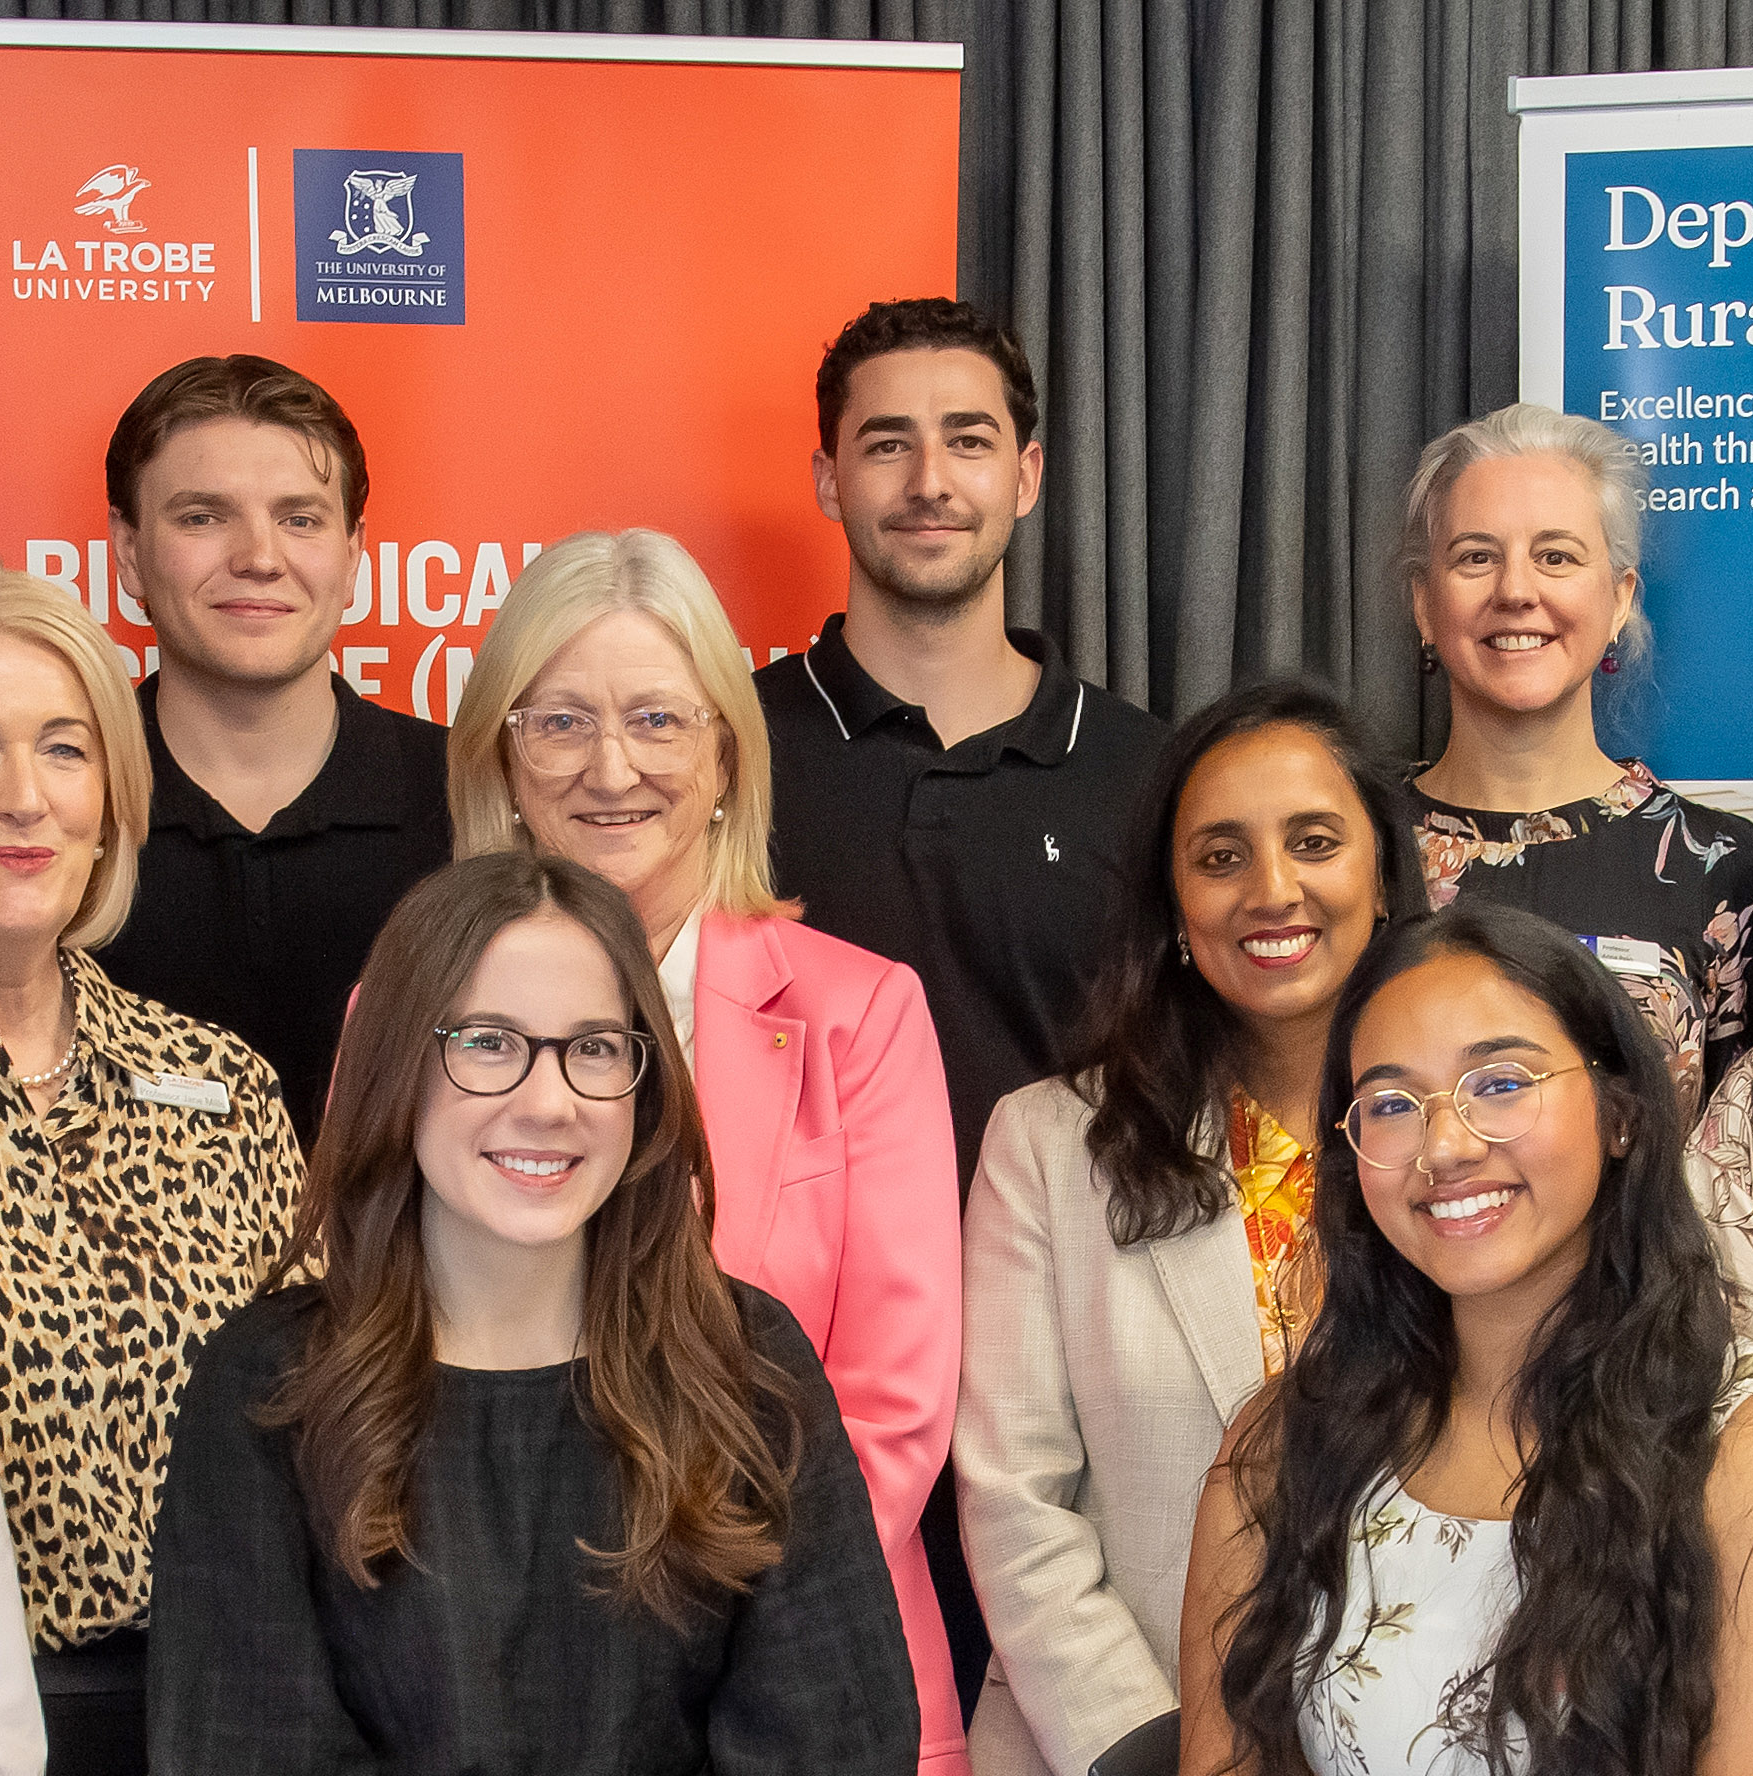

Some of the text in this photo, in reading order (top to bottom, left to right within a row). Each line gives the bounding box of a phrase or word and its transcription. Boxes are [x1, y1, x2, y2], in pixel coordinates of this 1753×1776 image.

[12, 240, 215, 273] LA TROBE
[315, 261, 446, 277] THE UNIVERSITY OF
[13, 278, 215, 302] UNIVERSITY
[317, 286, 447, 306] MELBOURNE
[1622, 432, 1703, 466] ealth
[1633, 477, 1740, 512] search
